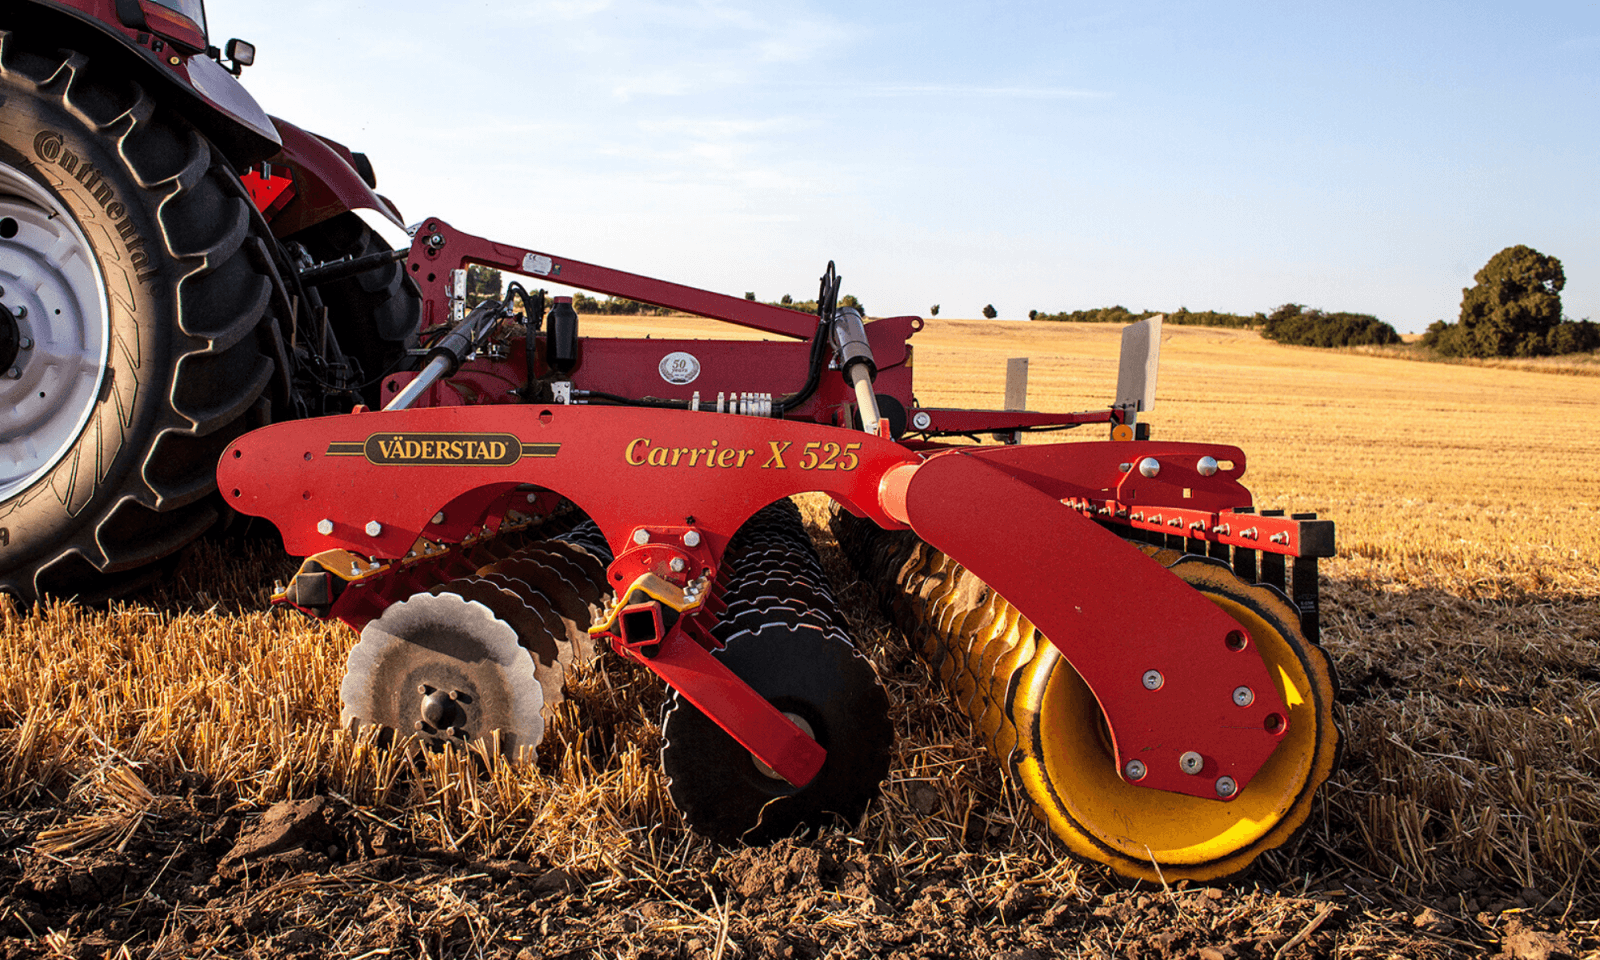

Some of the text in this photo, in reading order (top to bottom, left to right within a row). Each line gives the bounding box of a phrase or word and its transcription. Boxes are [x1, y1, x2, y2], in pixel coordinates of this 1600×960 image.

[33, 130, 157, 285] Continental
[672, 359, 686, 369] 50
[378, 436, 507, 460] VÄDERSTAD
[624, 437, 862, 471] Carrier X 525
